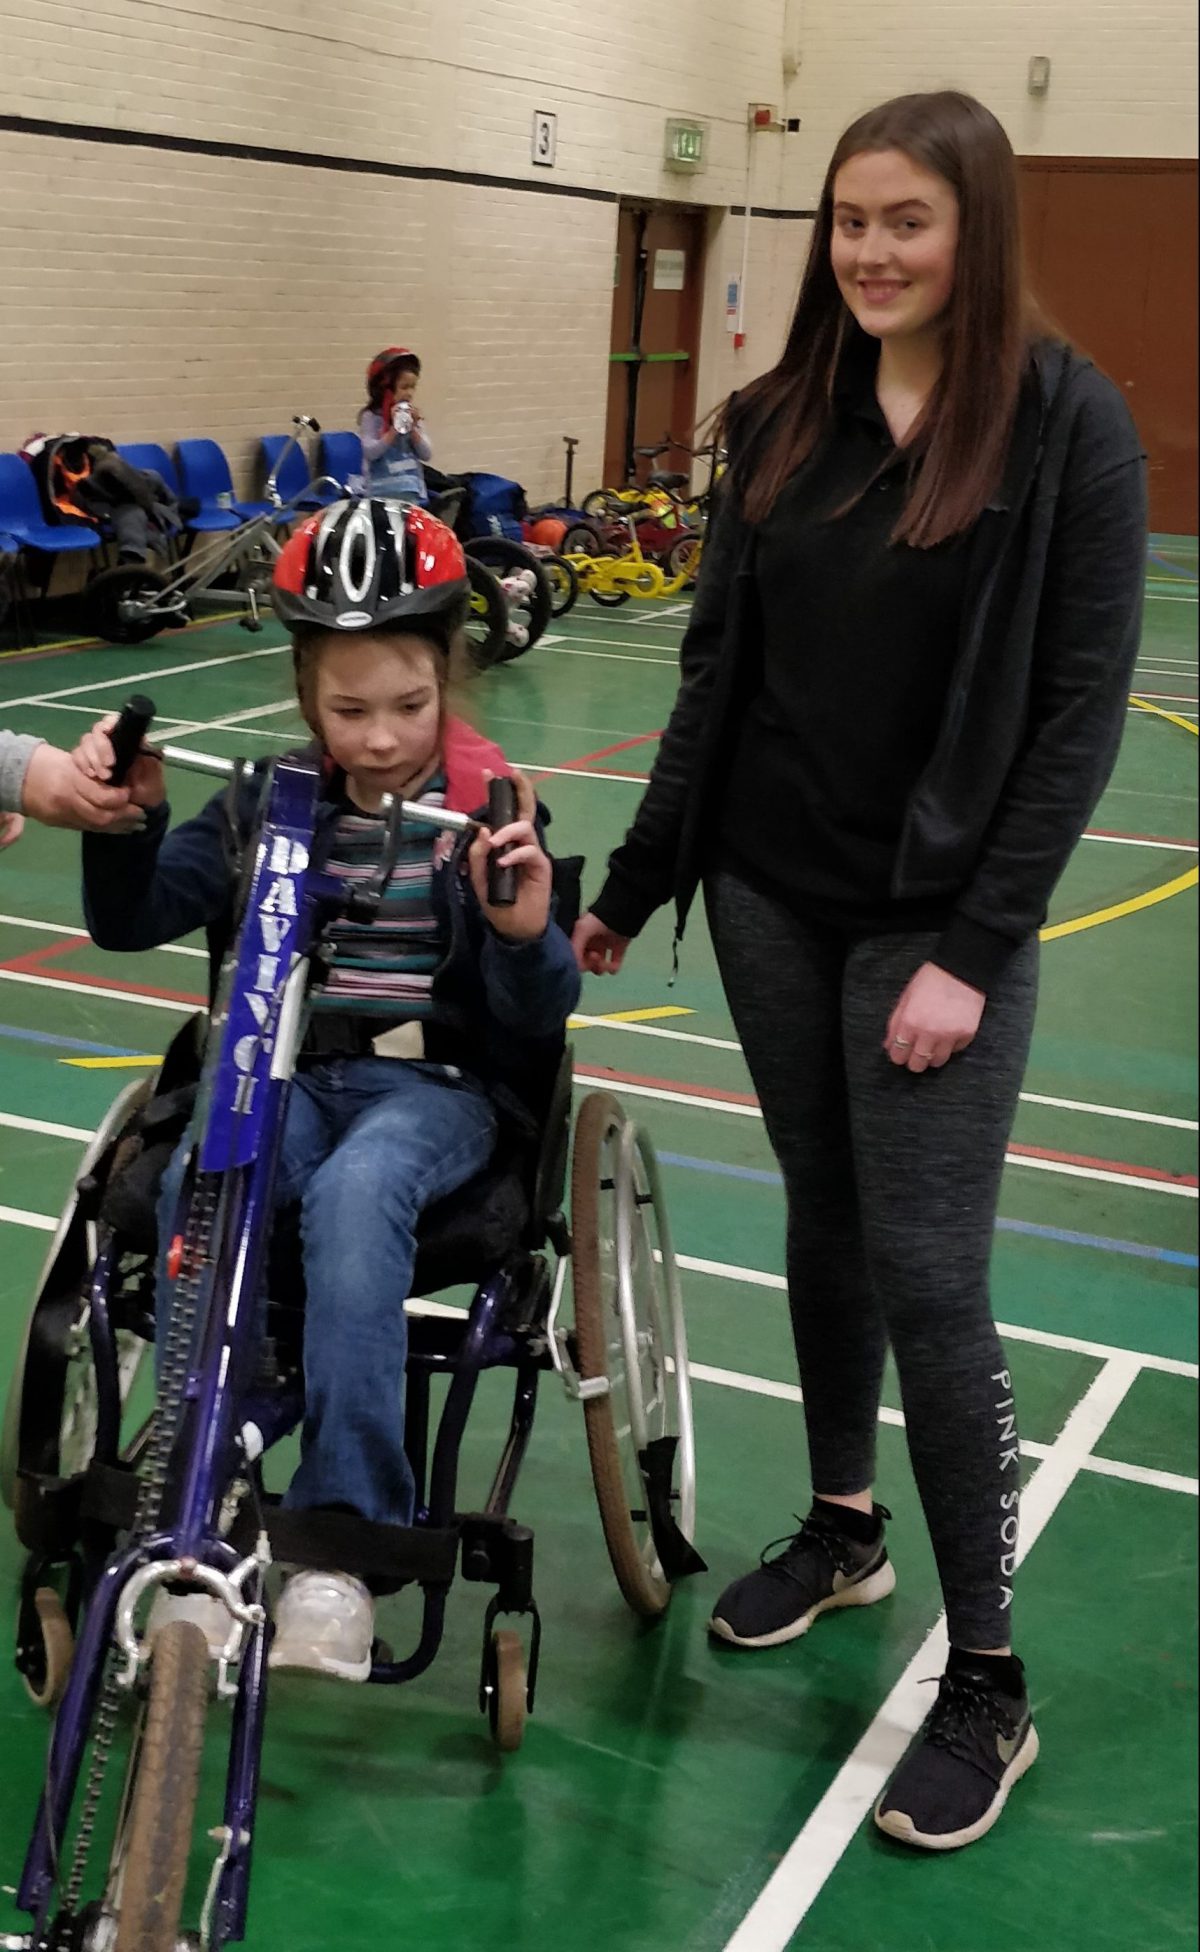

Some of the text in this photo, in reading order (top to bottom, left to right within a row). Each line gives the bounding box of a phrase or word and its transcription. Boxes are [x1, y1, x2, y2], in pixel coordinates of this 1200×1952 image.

[538, 121, 550, 156] 3
[990, 1368, 1020, 1610] PINK SODA
